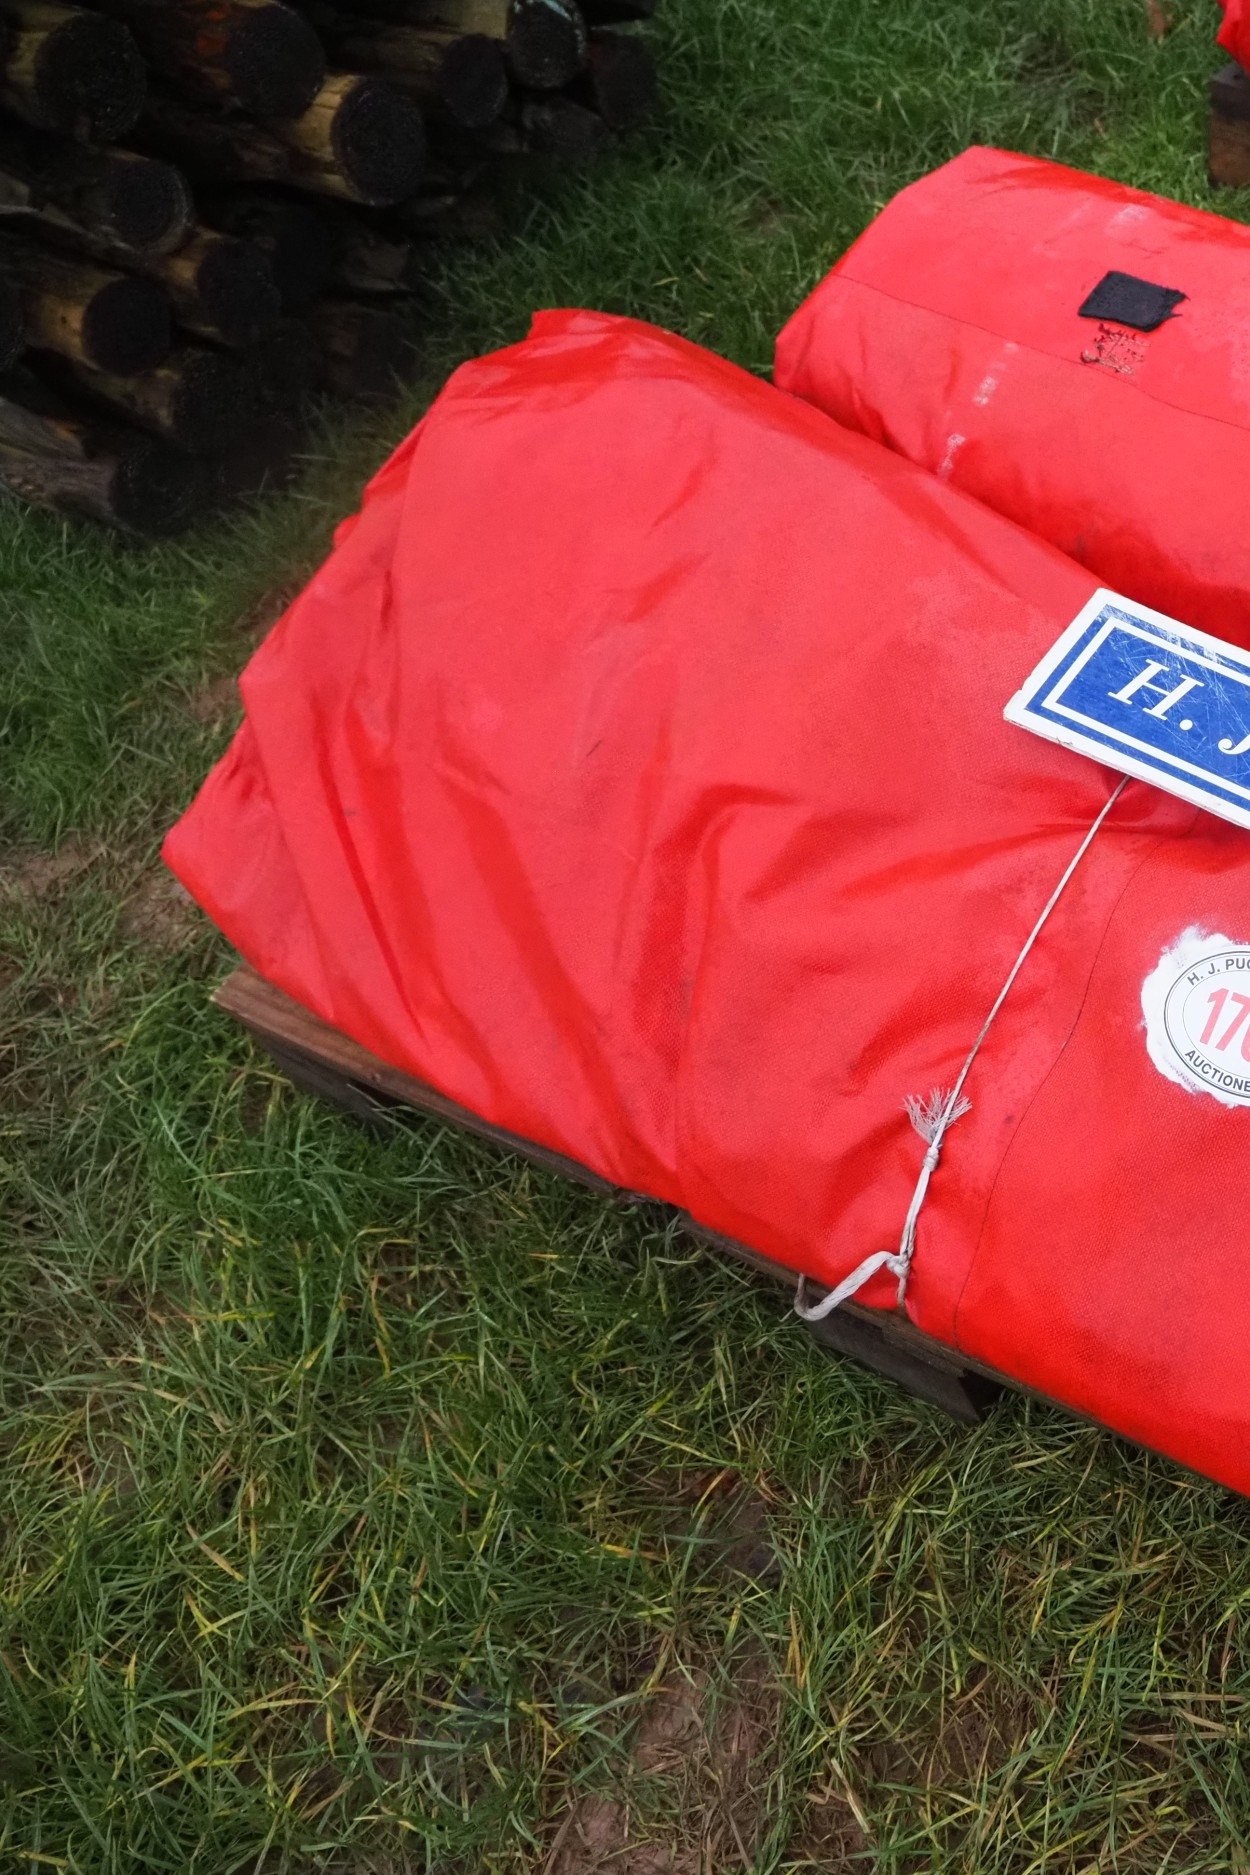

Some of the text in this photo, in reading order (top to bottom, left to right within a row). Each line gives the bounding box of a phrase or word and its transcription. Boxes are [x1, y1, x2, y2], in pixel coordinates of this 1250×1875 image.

[1107, 658, 1204, 732] H.
[1186, 971, 1204, 986] H.
[1207, 962, 1221, 975] J.
